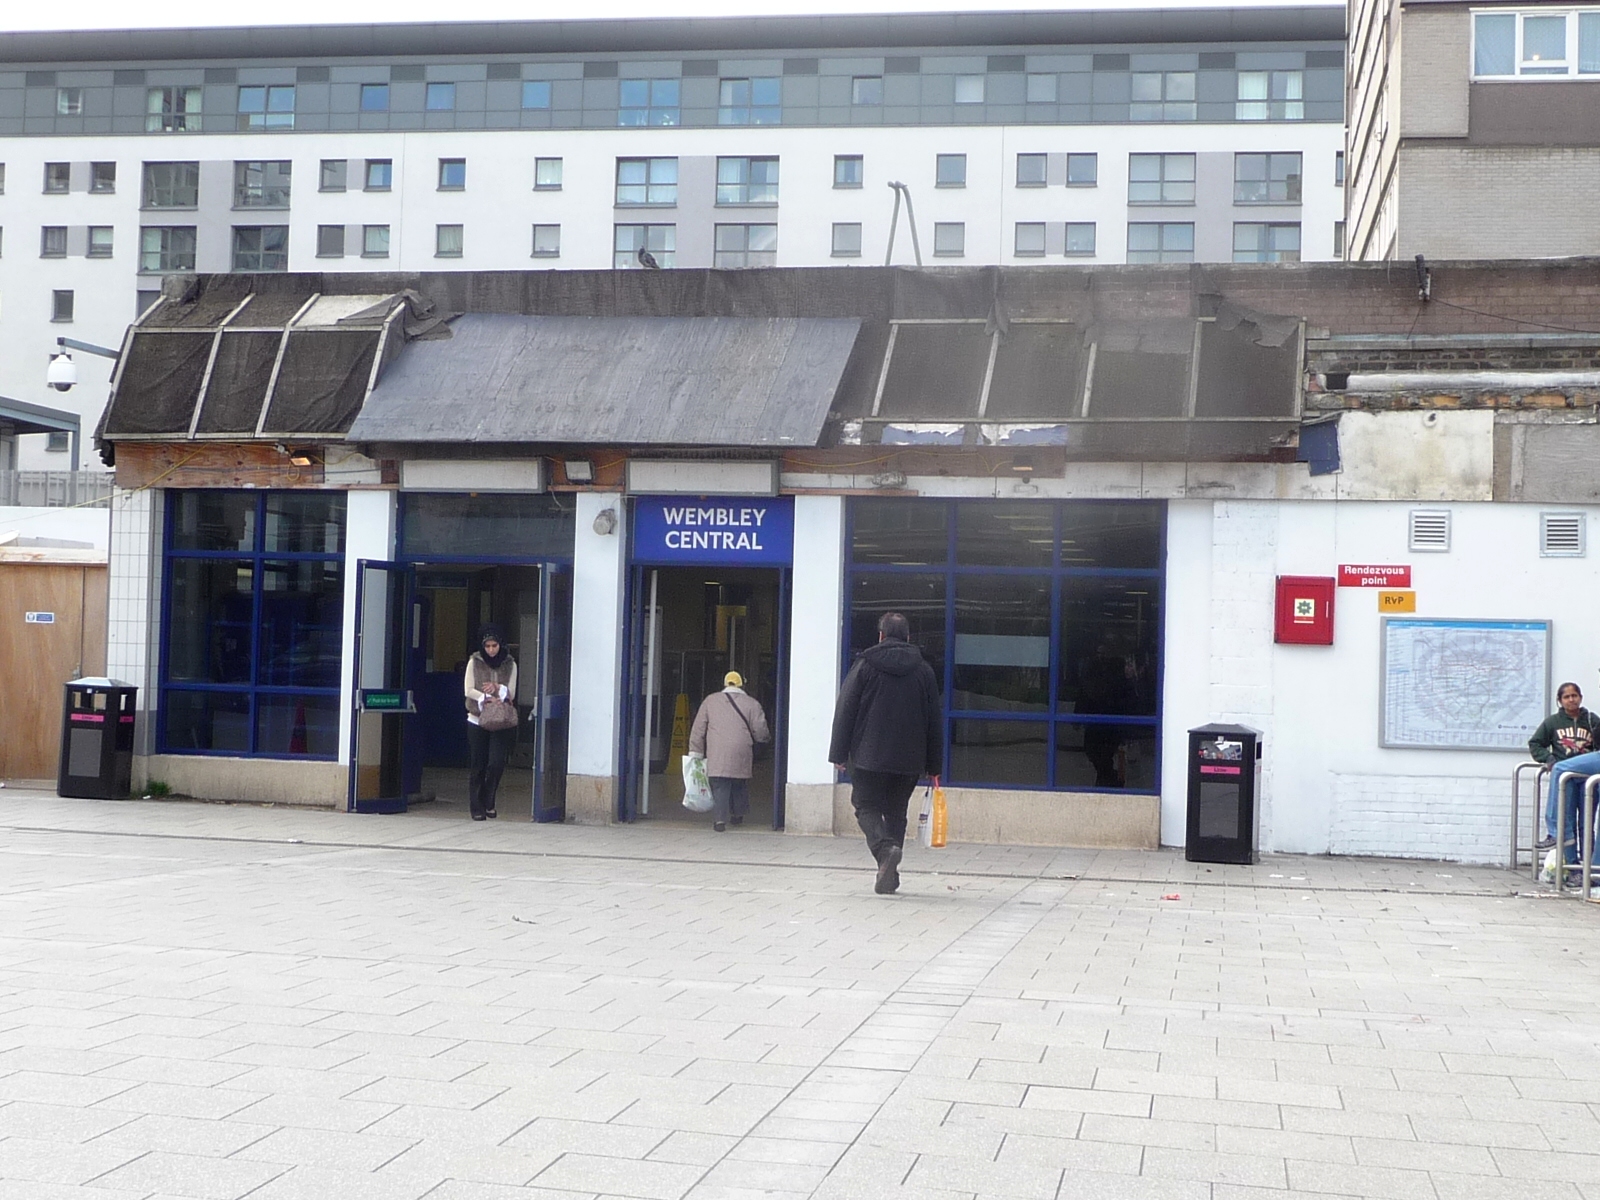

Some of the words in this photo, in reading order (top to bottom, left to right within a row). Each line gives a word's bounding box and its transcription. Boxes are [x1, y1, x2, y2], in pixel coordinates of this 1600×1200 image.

[663, 507, 766, 526] WEMBLEY
[665, 531, 763, 550] CENTRAL
[1344, 565, 1405, 575] Rendezvous
[1361, 576, 1387, 586] point
